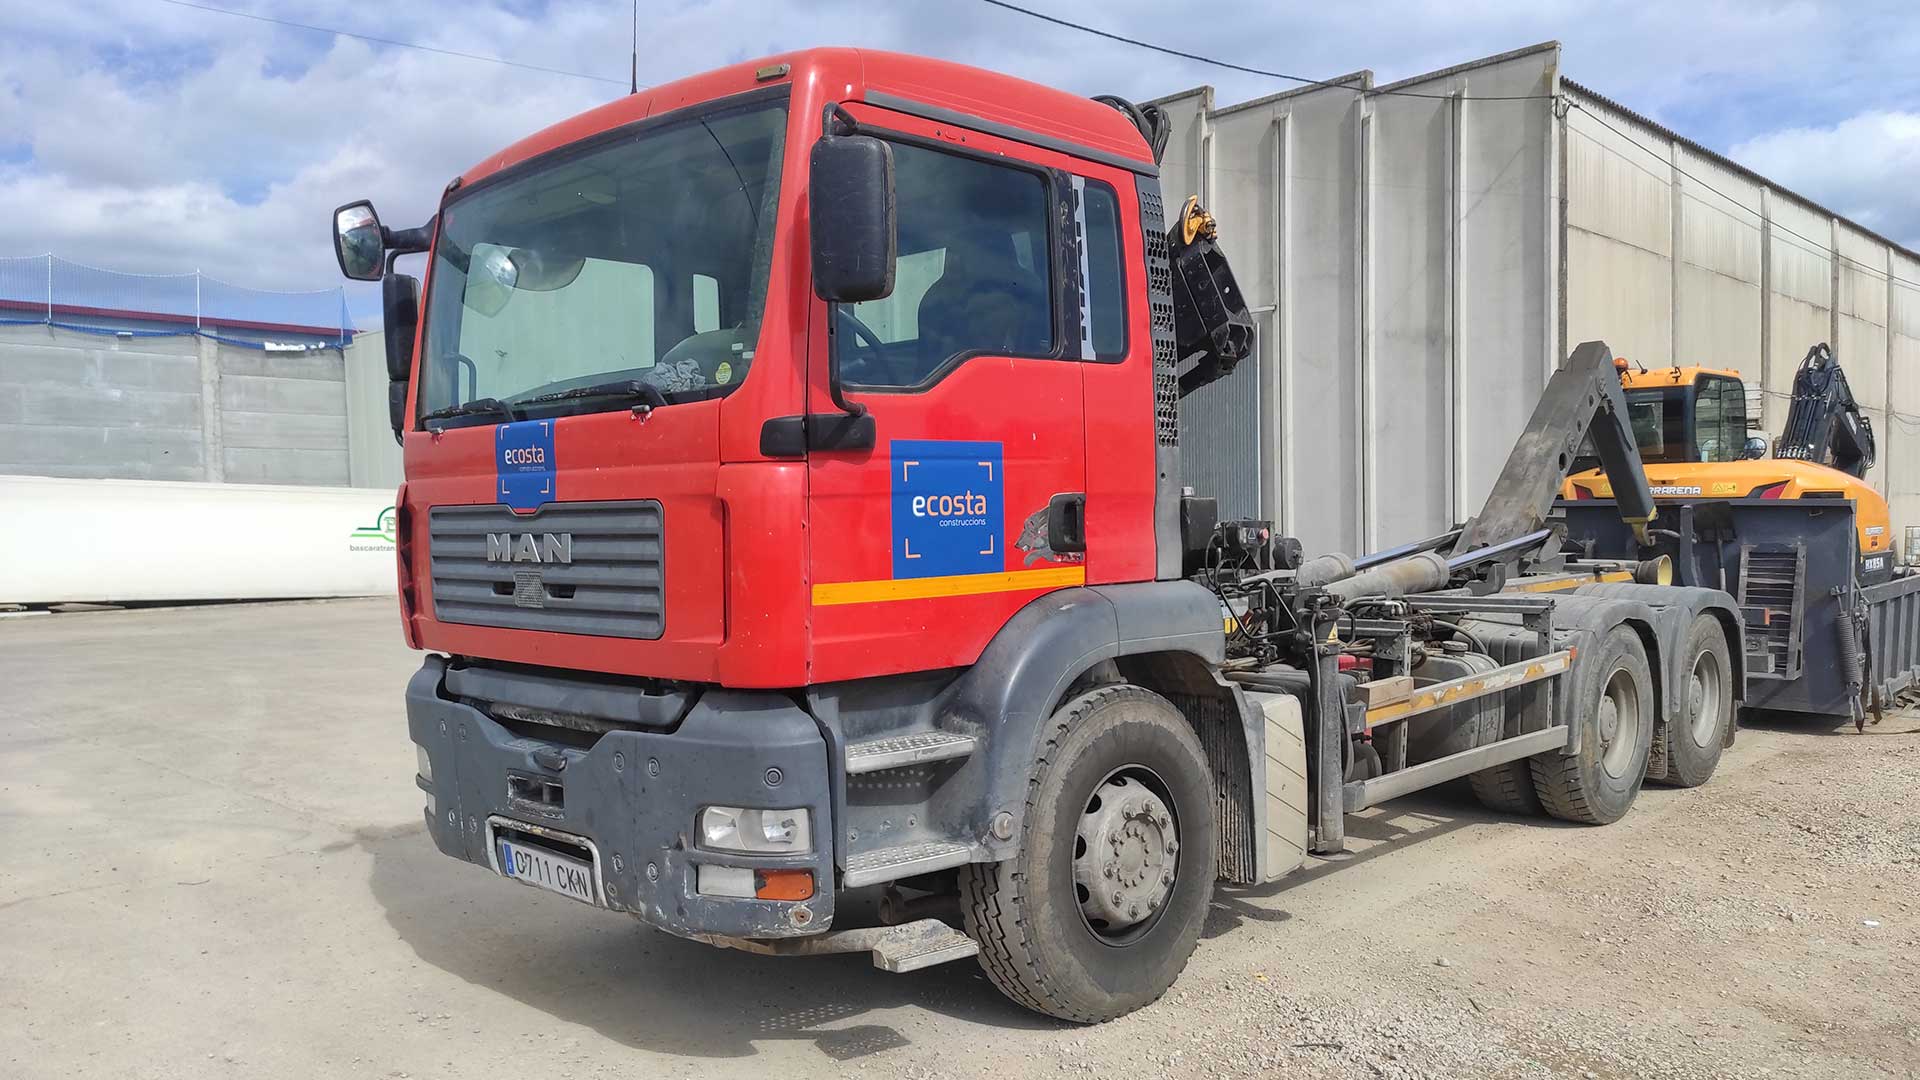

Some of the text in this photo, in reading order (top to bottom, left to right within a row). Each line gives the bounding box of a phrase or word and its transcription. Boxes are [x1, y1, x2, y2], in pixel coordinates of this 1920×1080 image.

[504, 443, 545, 465] ecosta
[912, 490, 987, 517] ecosta
[939, 517, 986, 527] construccions
[486, 533, 572, 563] MAN
[514, 850, 589, 897] 0711 CKN
